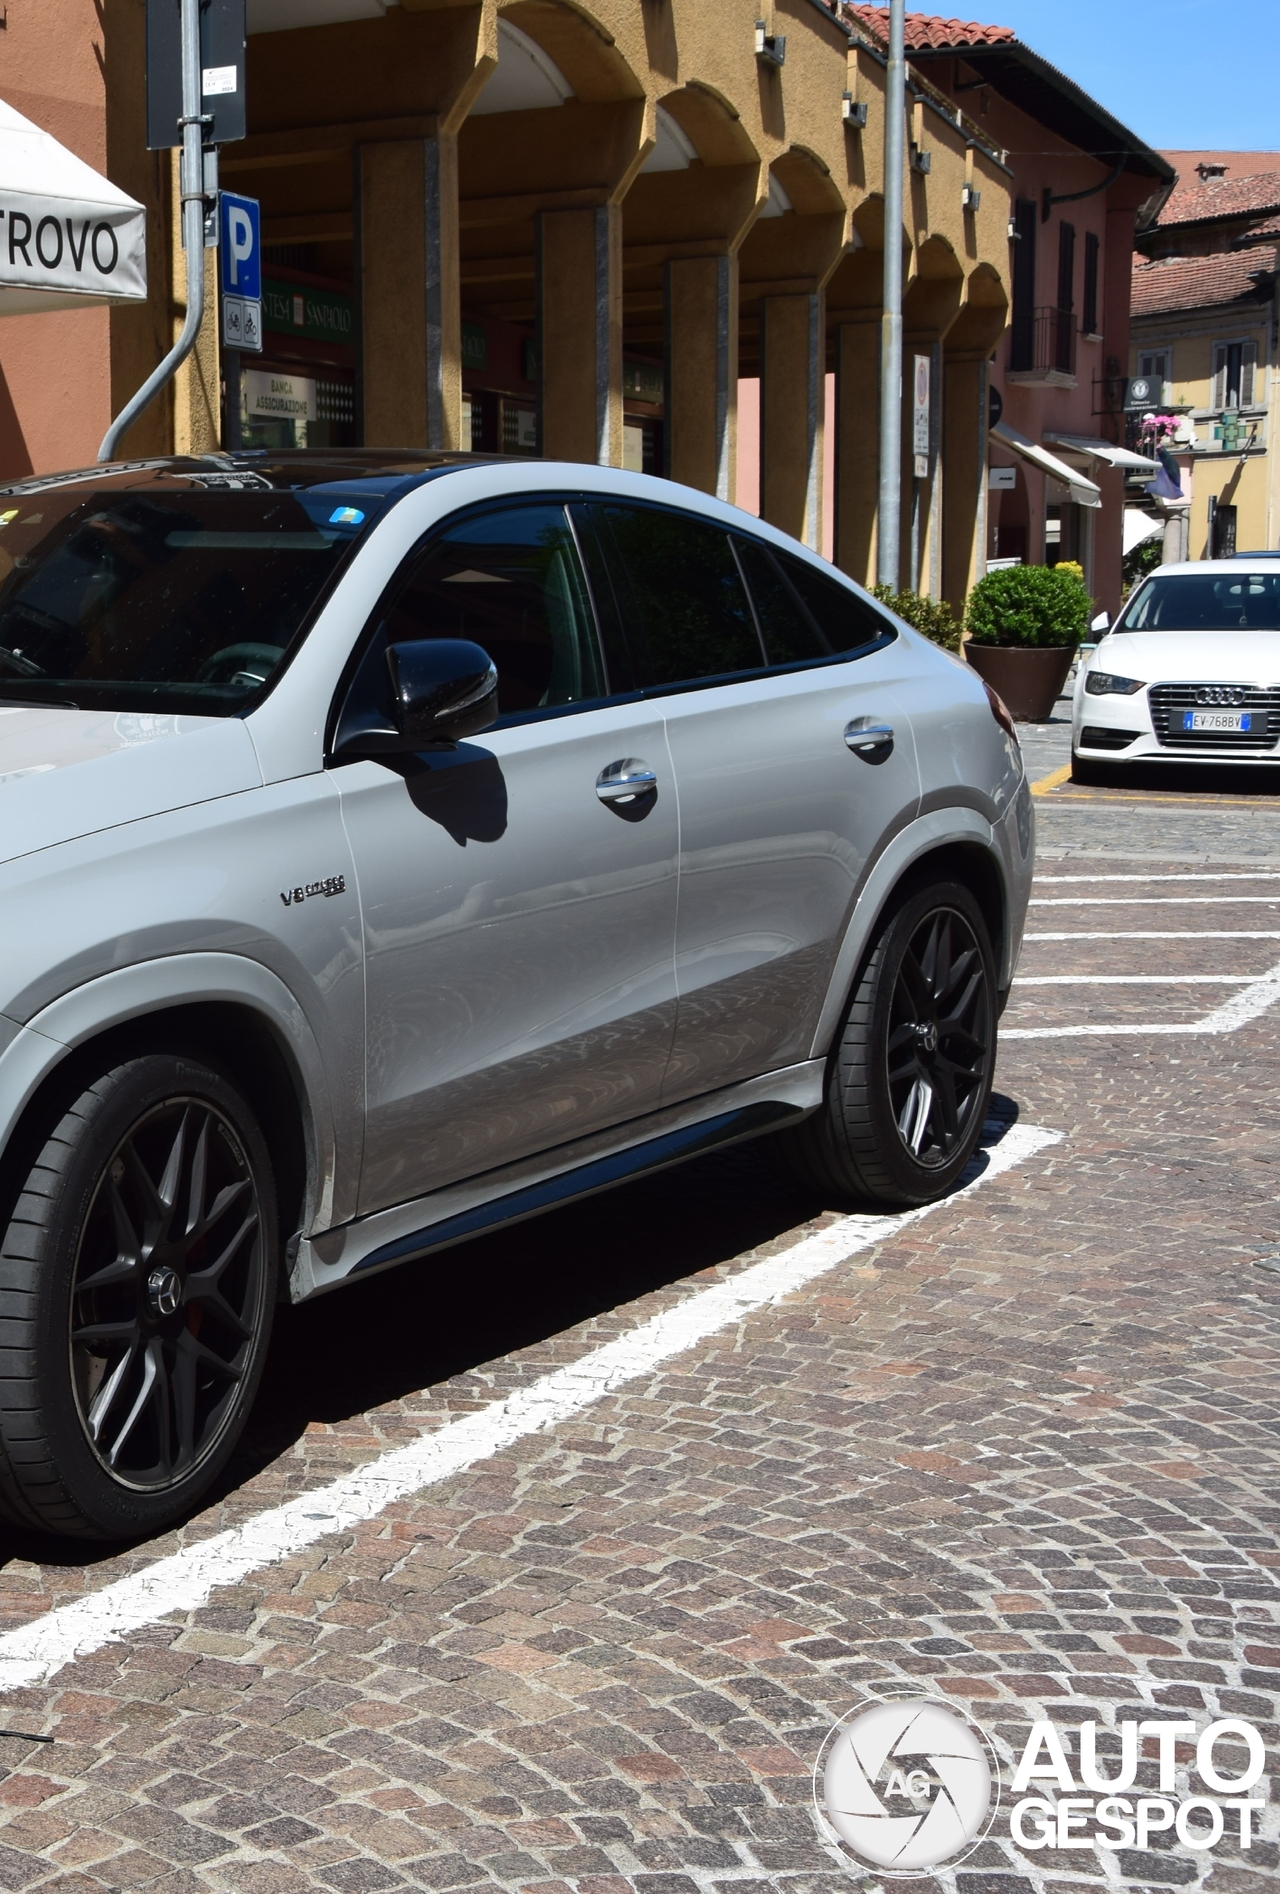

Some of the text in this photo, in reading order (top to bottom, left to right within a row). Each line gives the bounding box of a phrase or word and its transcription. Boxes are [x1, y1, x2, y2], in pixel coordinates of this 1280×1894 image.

[228, 205, 254, 286] P
[306, 299, 352, 333] SANPAOLO
[270, 379, 293, 396] BANCA
[255, 394, 308, 415] ASSICURAZIONE
[1209, 716, 1241, 728] 768BV
[279, 887, 305, 907] V8
